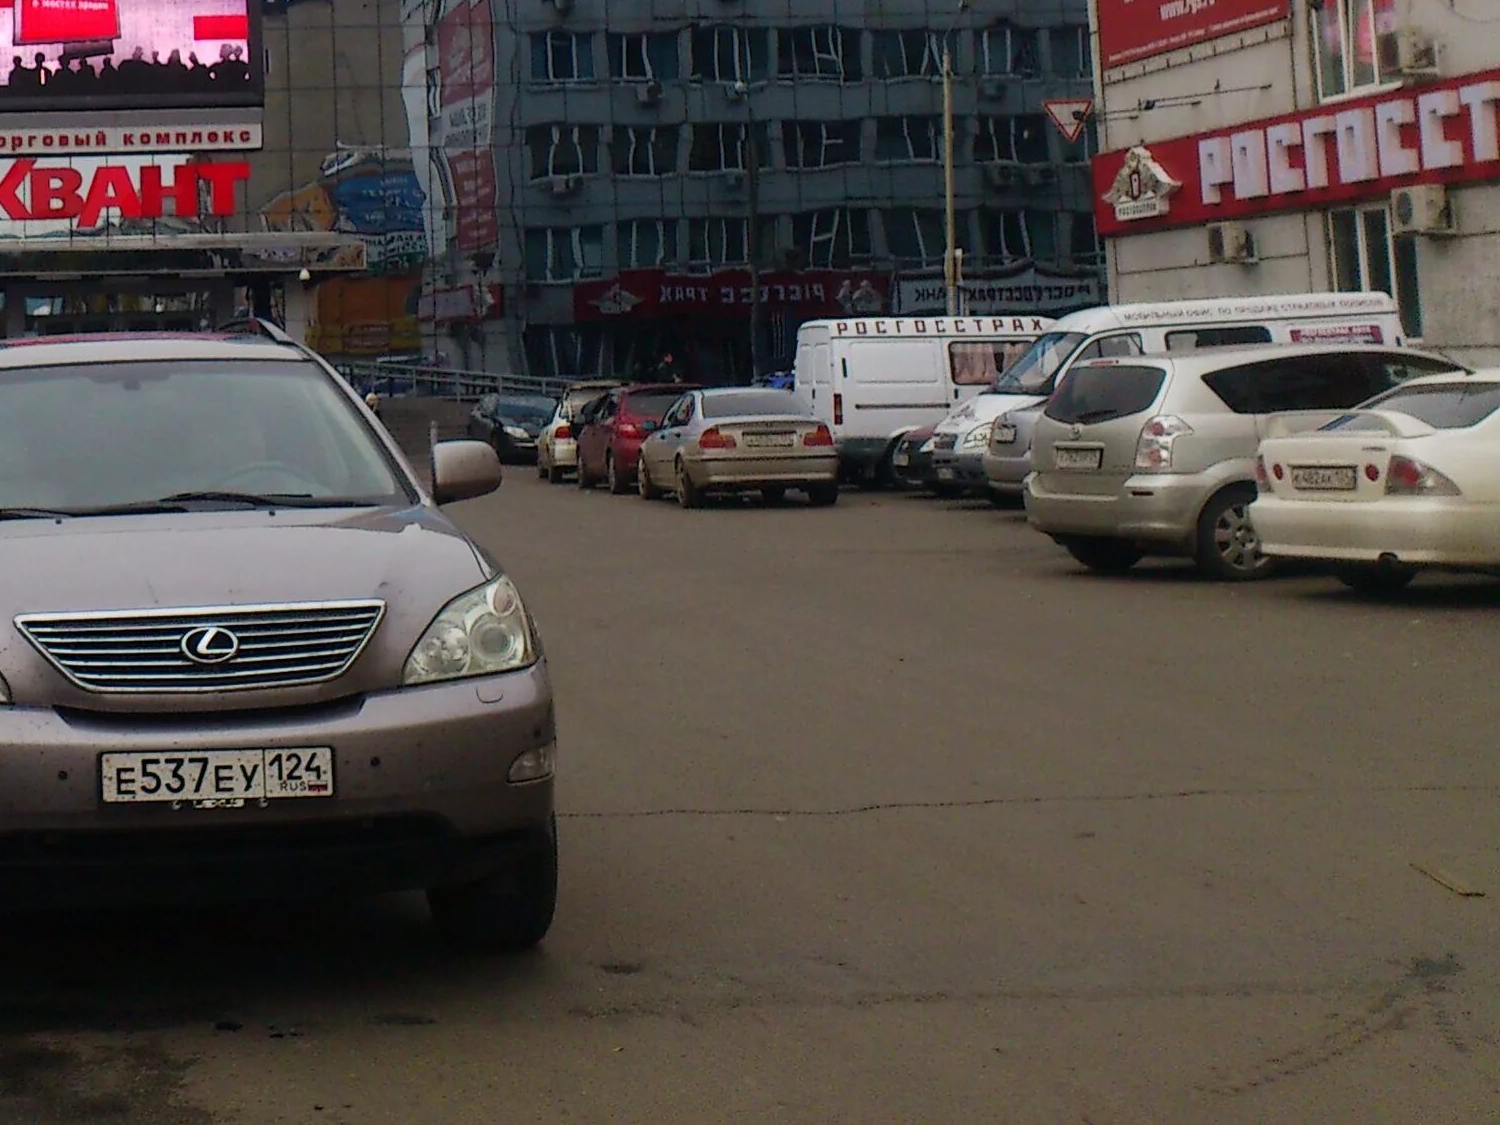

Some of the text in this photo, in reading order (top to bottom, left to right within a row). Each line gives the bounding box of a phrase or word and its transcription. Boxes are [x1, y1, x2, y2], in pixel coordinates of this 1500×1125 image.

[837, 318, 1043, 336] РОСГОССТРАХ
[269, 752, 323, 782] 124
[280, 782, 306, 792] RUS
